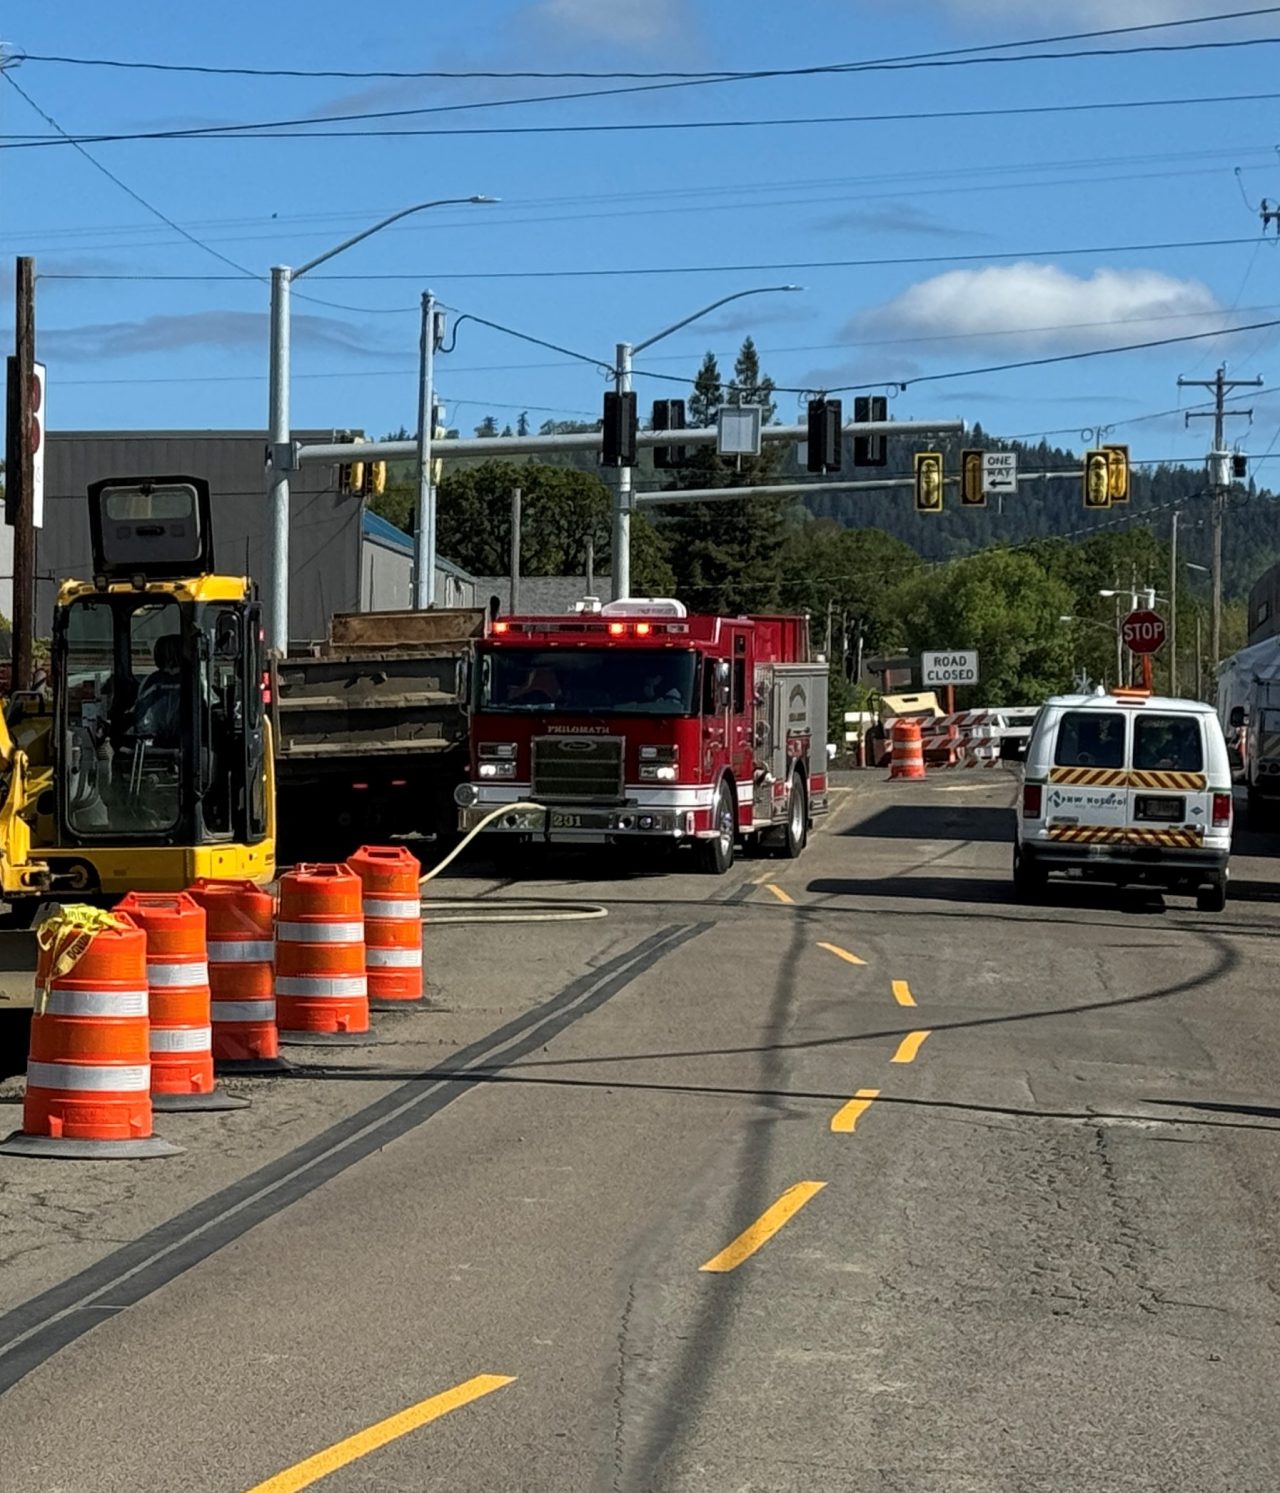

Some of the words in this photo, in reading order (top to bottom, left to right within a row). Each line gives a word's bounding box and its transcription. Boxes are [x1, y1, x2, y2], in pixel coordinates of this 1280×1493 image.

[987, 455, 1012, 466] ONE
[987, 468, 1011, 478] WAY
[1123, 622, 1164, 641] STOP
[933, 655, 968, 668] ROAD
[927, 668, 975, 681] CLOSED
[547, 725, 610, 734] PHILOMATH
